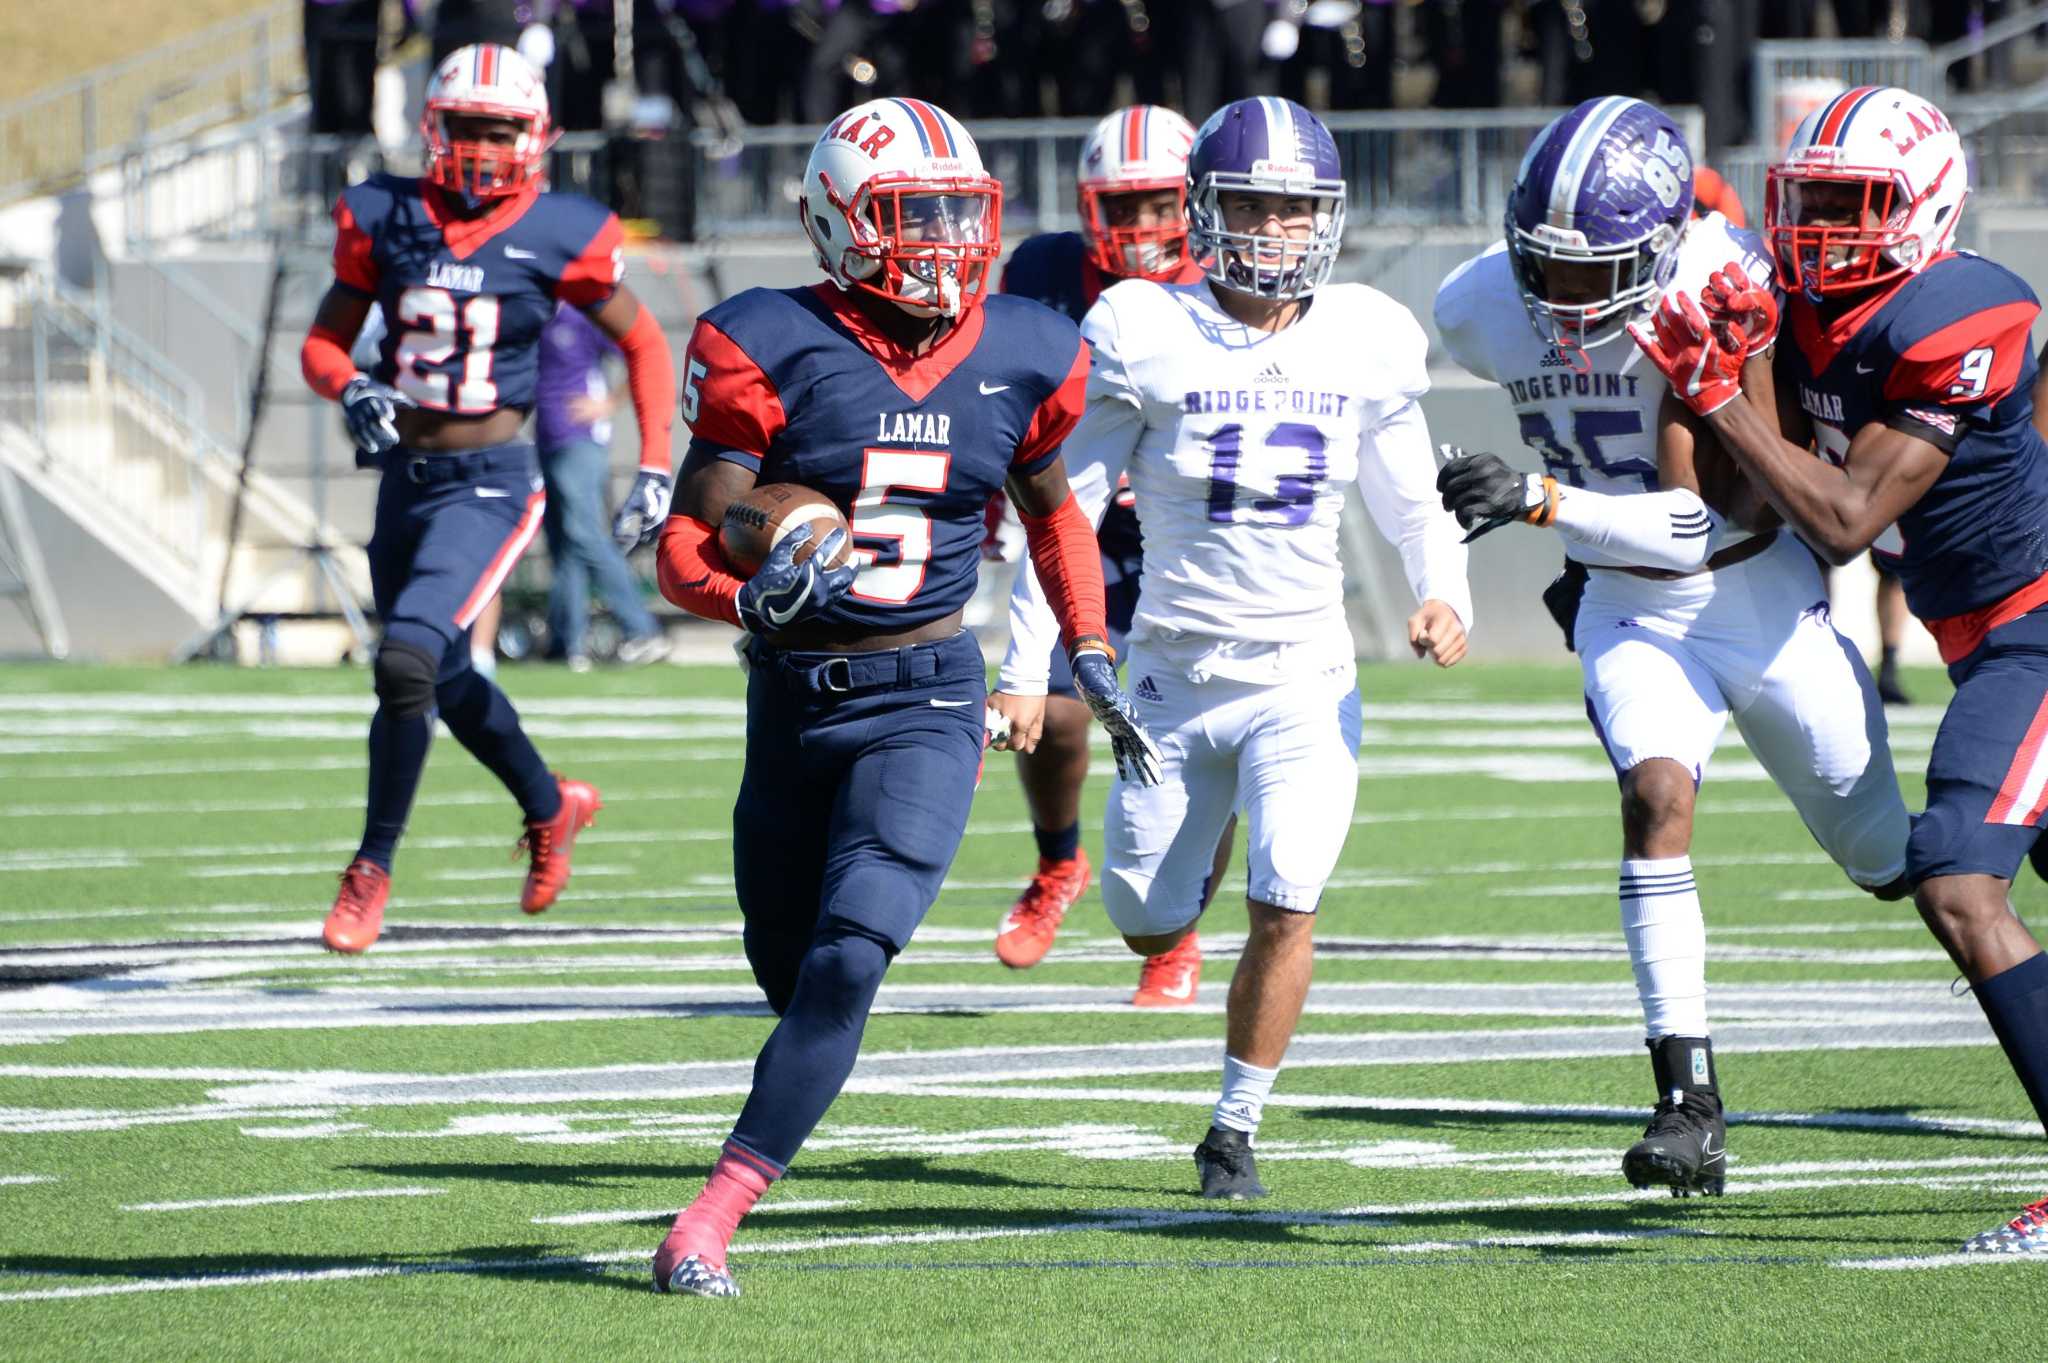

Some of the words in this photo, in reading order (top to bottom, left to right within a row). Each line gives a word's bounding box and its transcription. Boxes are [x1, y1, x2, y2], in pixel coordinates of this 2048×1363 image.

[1642, 129, 1690, 208] 85
[427, 261, 485, 293] LAMAR
[396, 288, 501, 414] 21
[1948, 347, 1995, 398] 9
[682, 361, 706, 422] 5
[878, 413, 951, 445] LAMAR
[850, 448, 951, 605] 5
